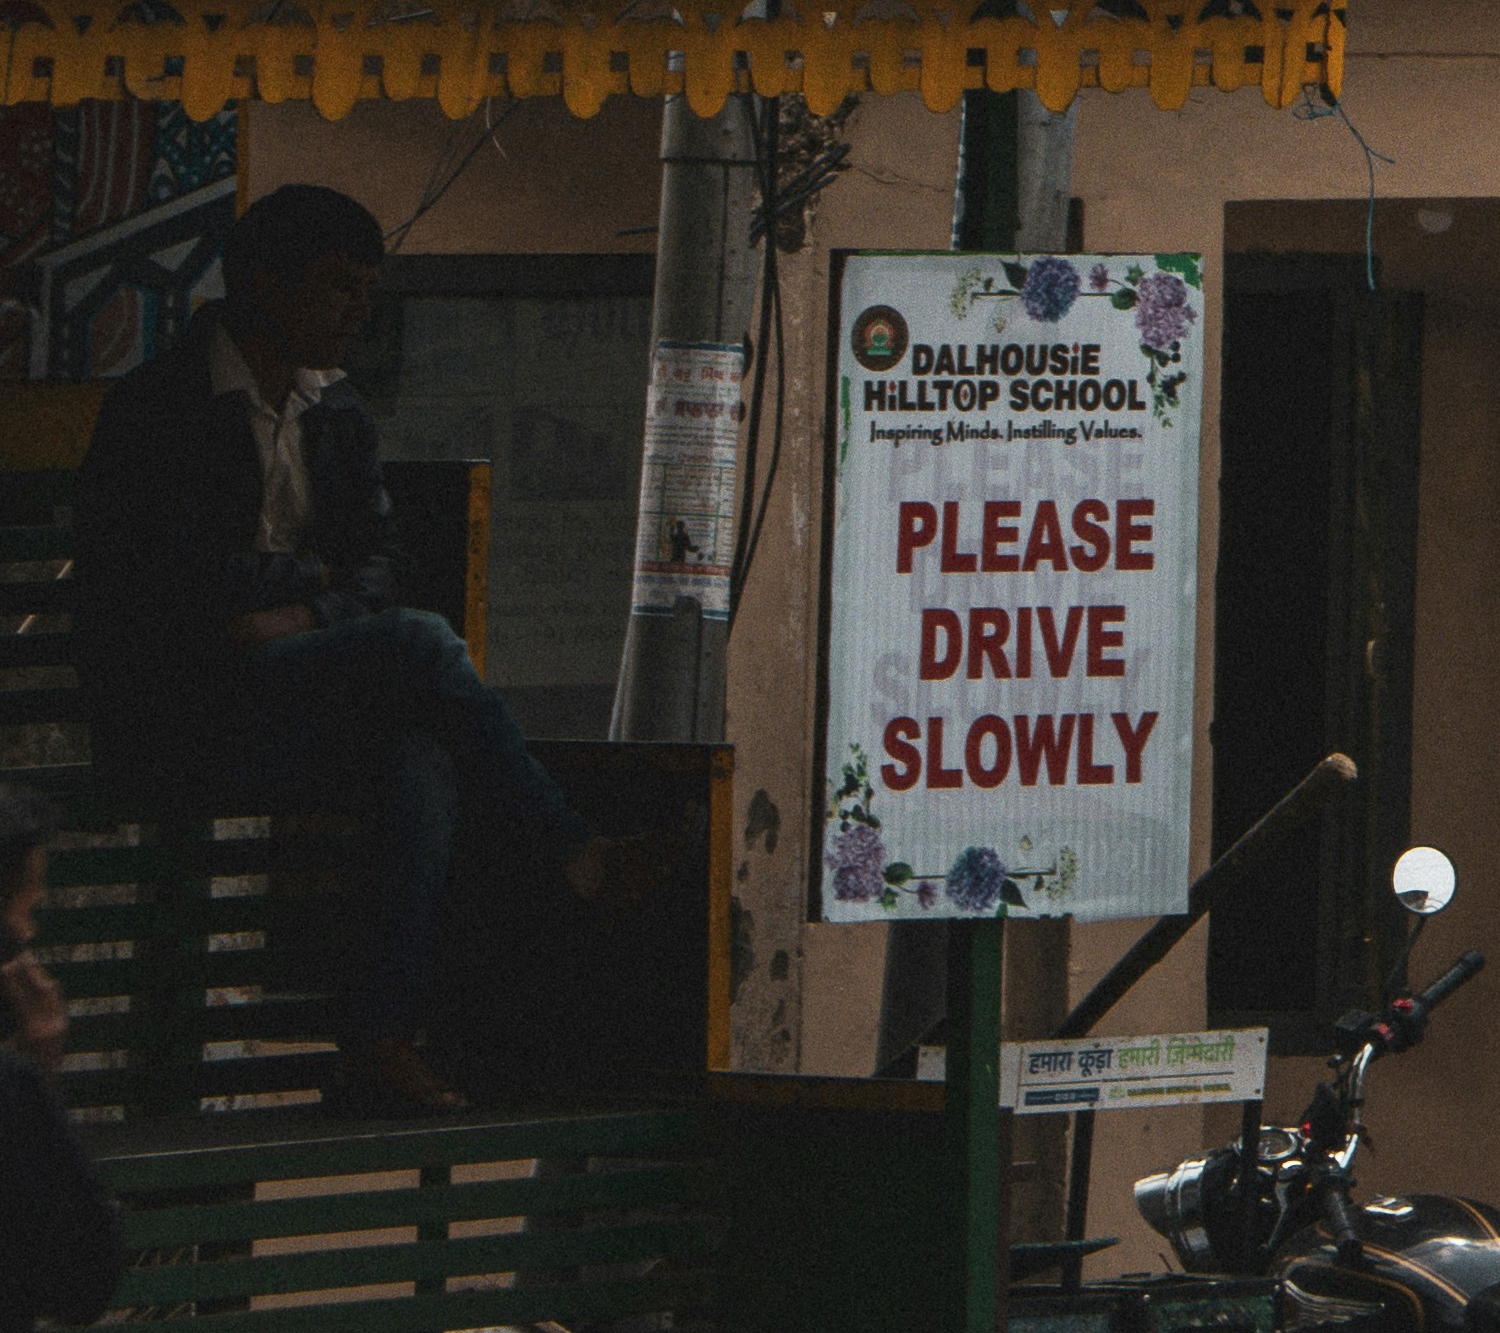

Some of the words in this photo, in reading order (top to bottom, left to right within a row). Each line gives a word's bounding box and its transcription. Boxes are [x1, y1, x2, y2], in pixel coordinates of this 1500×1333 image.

[1009, 379, 1147, 412] SCHOOL
[869, 420, 944, 448] Inspiring
[1007, 419, 1077, 446] Instilling
[1079, 419, 1143, 441] Values.
[896, 499, 1156, 574] PLEASE
[919, 605, 1127, 681] DRIVE
[880, 711, 1160, 792] SLOWLY
[1027, 1051, 1074, 1075] हमारा
[1117, 1038, 1161, 1070] हमारी
